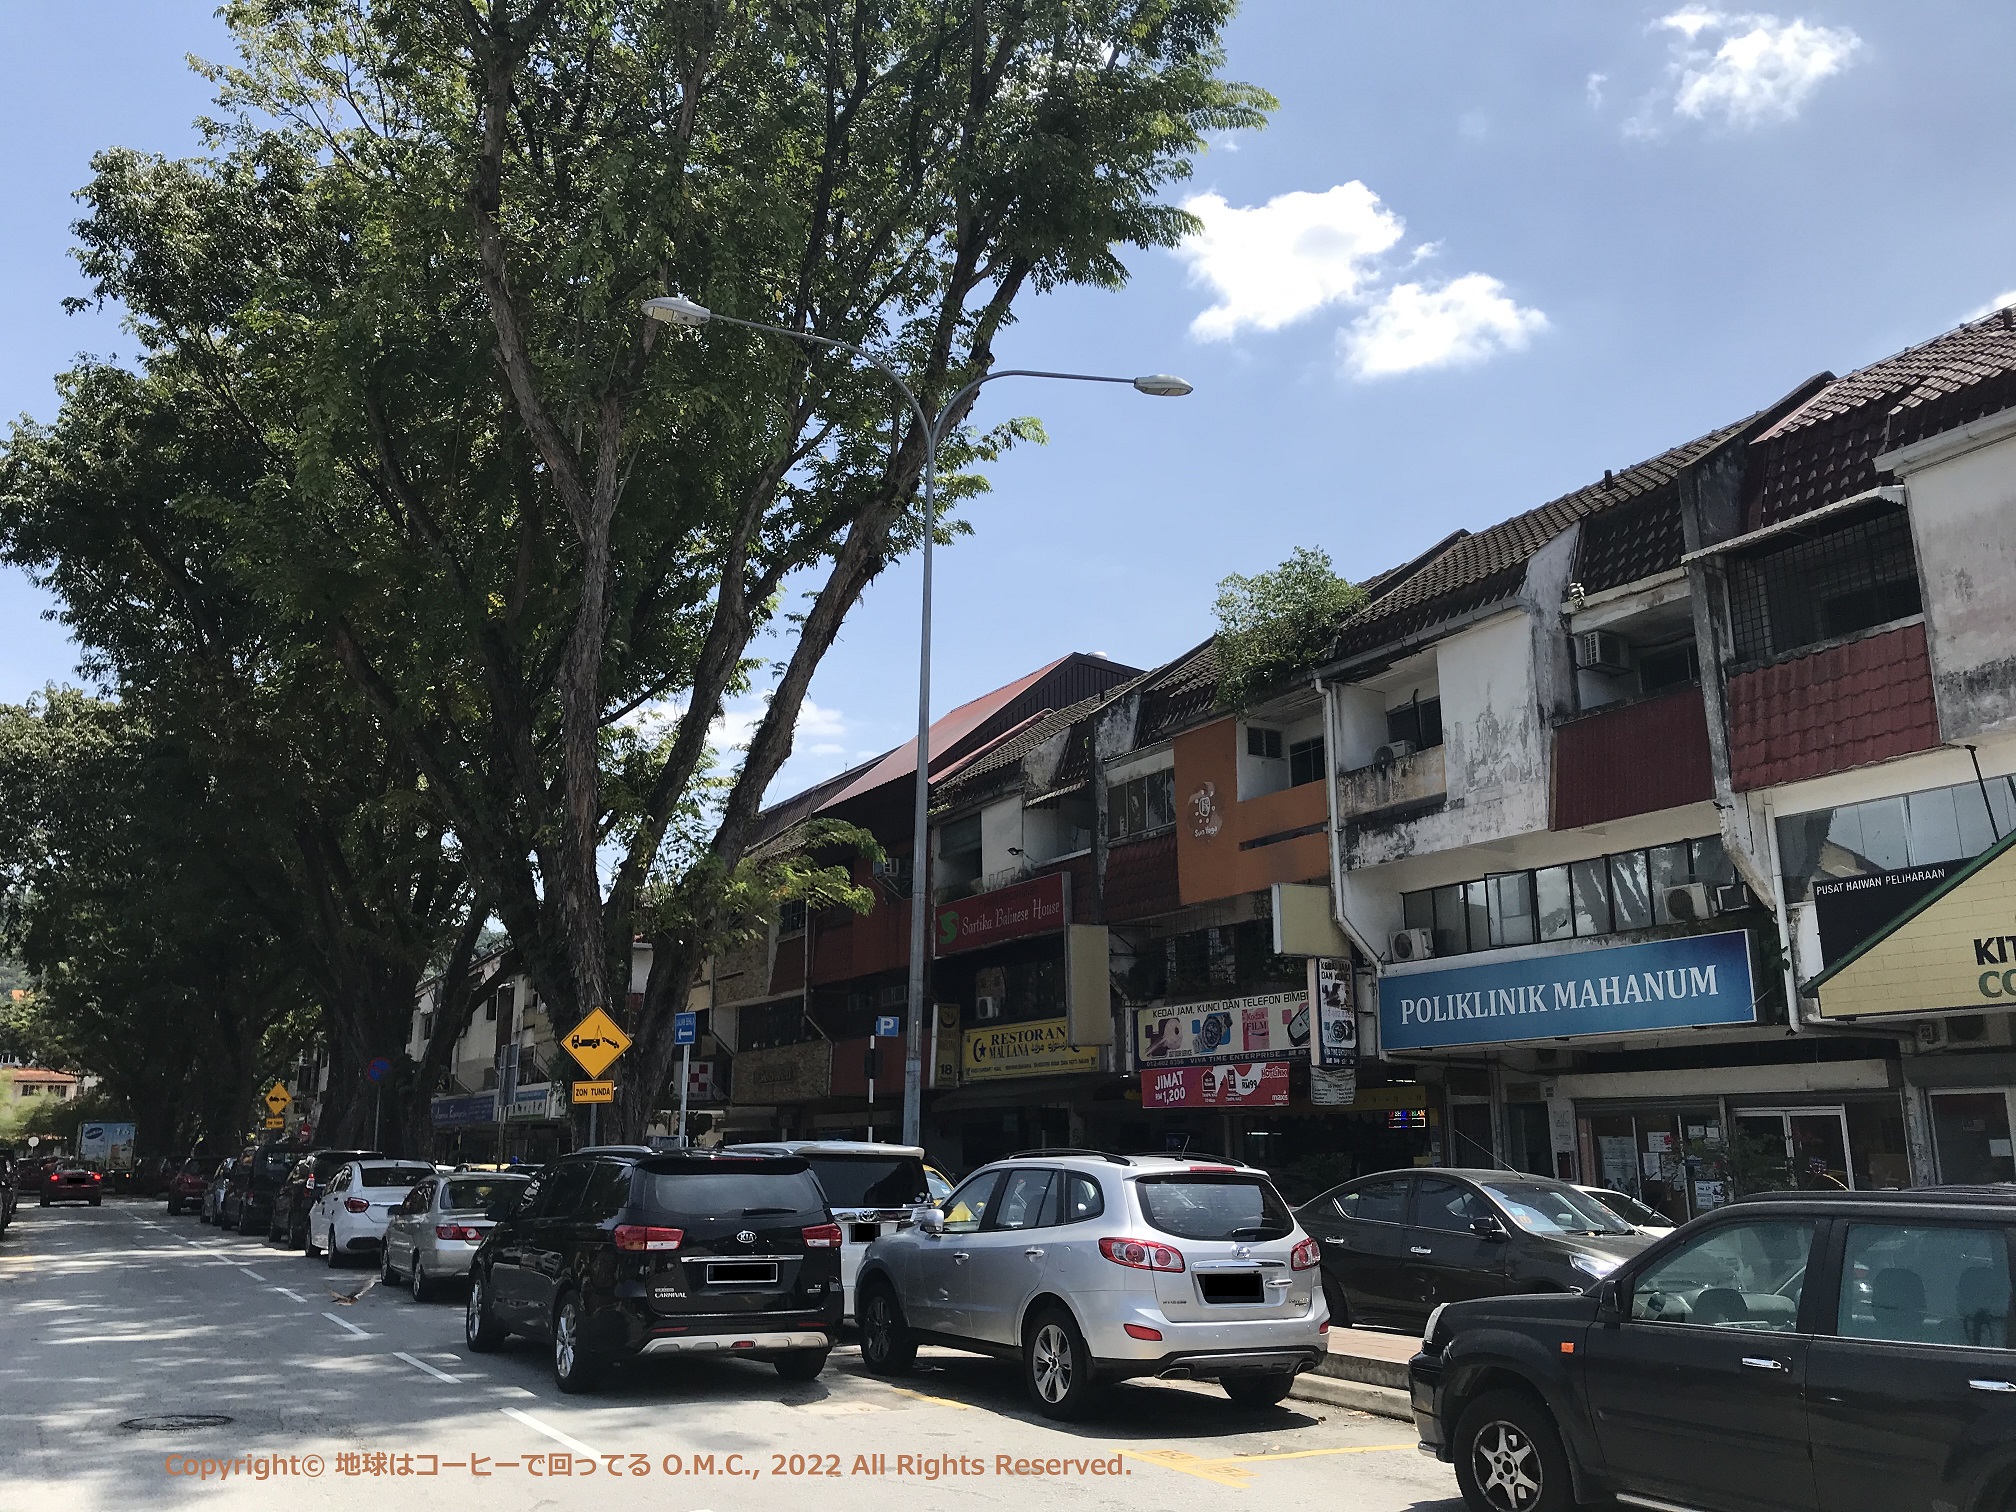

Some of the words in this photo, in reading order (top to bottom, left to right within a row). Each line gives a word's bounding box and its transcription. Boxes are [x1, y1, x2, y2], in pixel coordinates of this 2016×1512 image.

[1816, 882, 1843, 896] PUSAT
[1846, 876, 1882, 892] HAIWAN
[1885, 868, 1945, 885] PELIHARAAN
[962, 914, 992, 936] Sartika
[993, 907, 1029, 927] Balinese
[1033, 898, 1060, 919] House
[1400, 984, 1548, 1025] POLIKLINIK
[1554, 965, 1719, 1010] MAHANUM
[1152, 1007, 1175, 1018] KEDAI
[1197, 1001, 1220, 1013] KUNCI
[1223, 999, 1240, 1010] DAN
[1242, 994, 1280, 1007] TELEFON
[880, 1018, 894, 1035] P
[1247, 1021, 1267, 1031] FILM
[991, 1025, 1067, 1046] RESTORAN
[989, 1043, 1029, 1059] MAULANA
[1209, 1054, 1227, 1062] TIME
[1230, 1050, 1281, 1061] ENTERPRISE
[939, 1064, 953, 1075] 18
[1155, 1071, 1184, 1090] JIMAT
[575, 1088, 588, 1097] ZON
[591, 1087, 611, 1096] TUNDA
[1272, 1090, 1288, 1101] maxis
